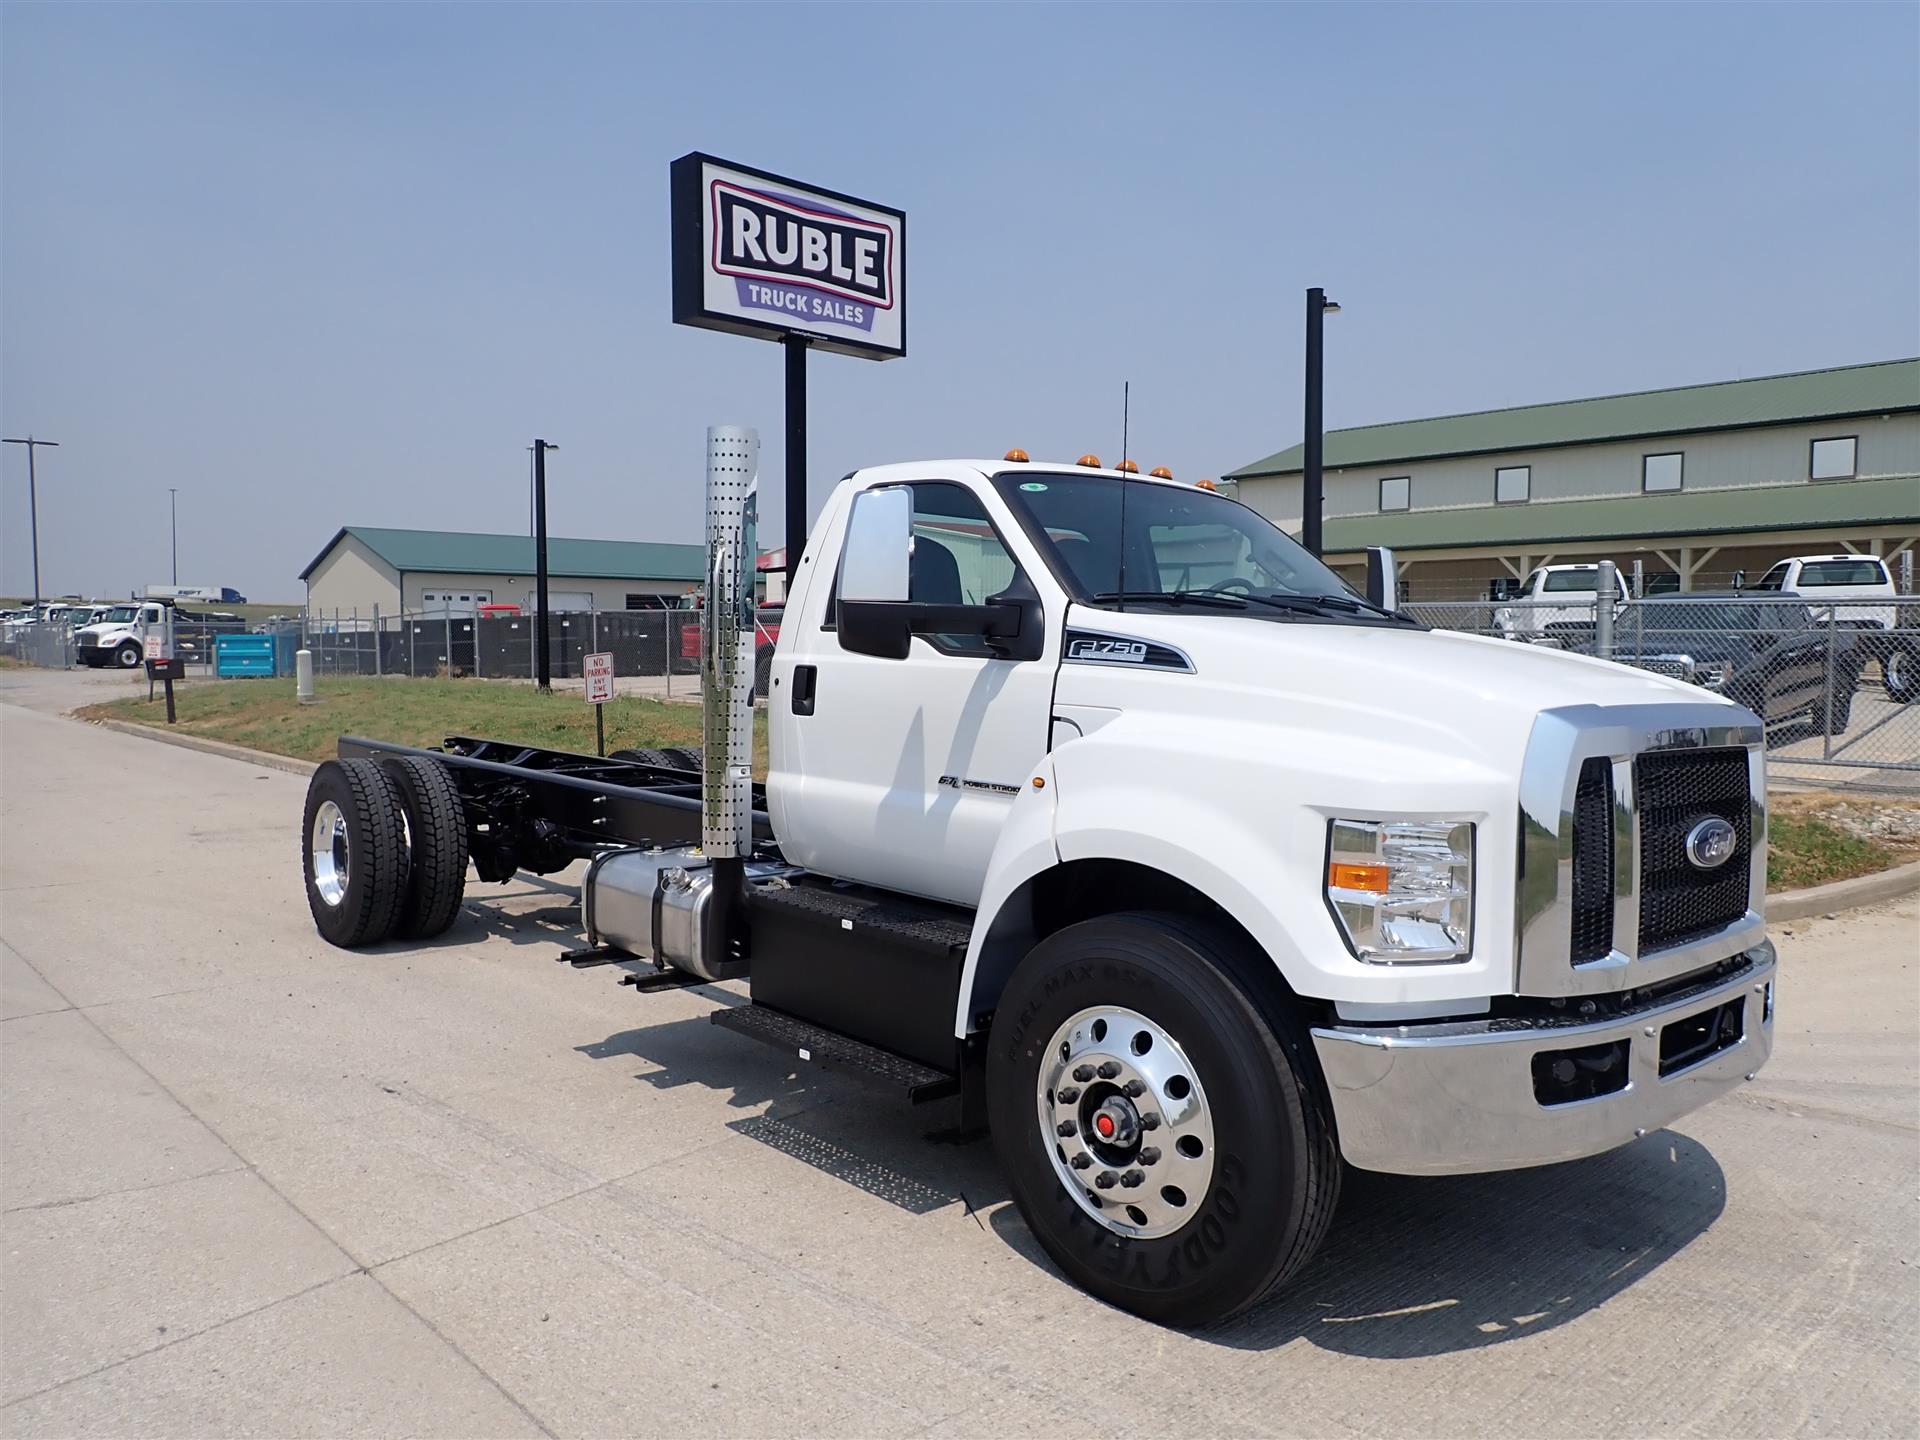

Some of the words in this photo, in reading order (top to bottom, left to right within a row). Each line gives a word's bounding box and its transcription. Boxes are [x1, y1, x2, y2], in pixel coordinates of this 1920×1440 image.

[732, 204, 878, 289] RUBLE
[749, 284, 808, 313] TRUCK
[812, 298, 864, 324] SALES
[587, 666, 611, 678] PARKING
[593, 657, 604, 667] NO
[593, 684, 607, 693] TIME
[962, 780, 990, 789] POWER
[1705, 829, 1731, 857] Ford
[1045, 964, 1097, 997] MAX
